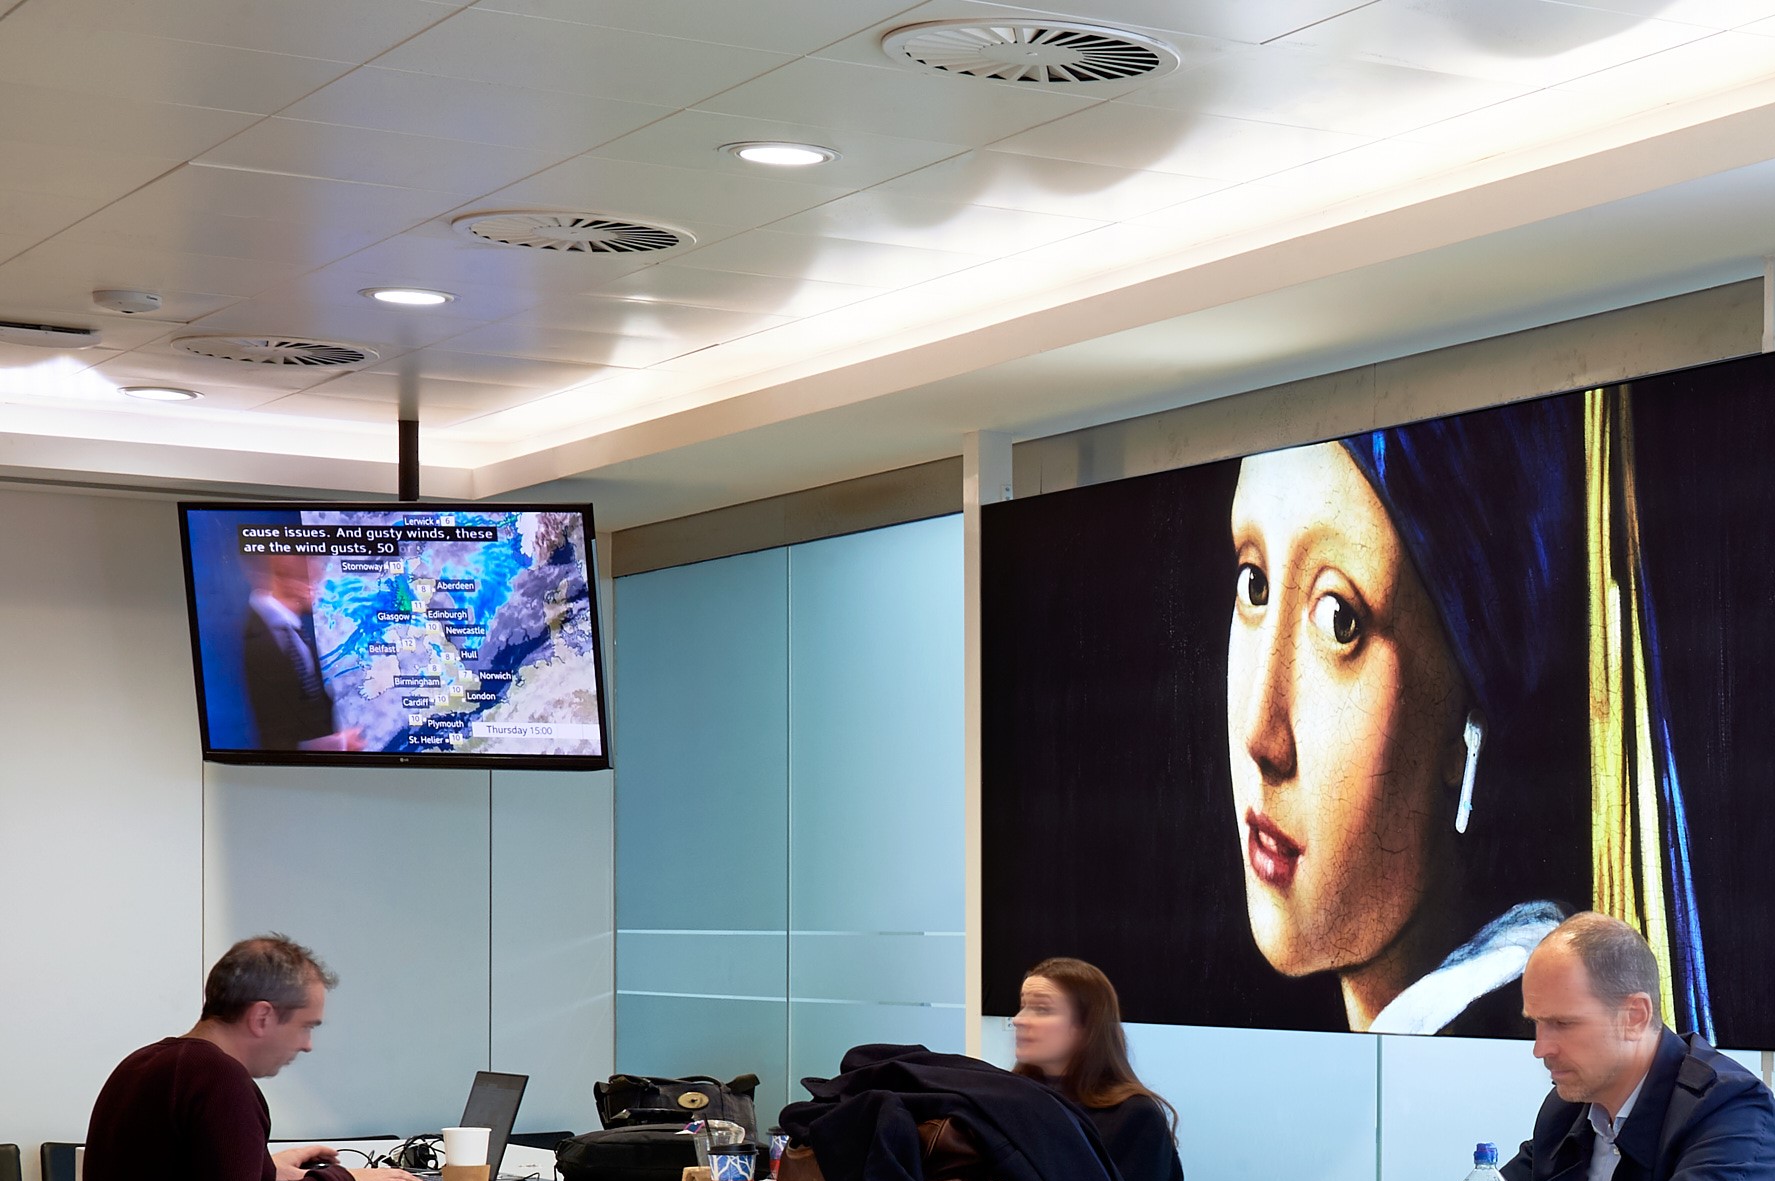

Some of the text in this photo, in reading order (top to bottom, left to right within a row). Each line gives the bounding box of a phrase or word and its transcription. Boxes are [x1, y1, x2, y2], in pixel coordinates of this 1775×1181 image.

[404, 516, 434, 526] Lerwick
[242, 526, 493, 541] cause issues. And gusty winds, these
[243, 543, 265, 553] are
[269, 542, 291, 553] the
[296, 541, 326, 553] wind
[330, 543, 371, 555] gusts,
[341, 561, 383, 572] Stornoway
[392, 562, 401, 570] 10
[436, 580, 475, 591] Aberdeen
[377, 612, 410, 622] Glasgow
[427, 610, 467, 621] Edinburgh
[445, 626, 485, 635] Newcastle
[369, 643, 396, 653] Belfast
[461, 650, 478, 659] Hull
[479, 671, 512, 680] Norwich
[394, 677, 440, 687] Birmingham
[466, 692, 496, 701] London
[403, 698, 429, 706] Cardiff
[427, 719, 464, 729] Plymouth
[486, 725, 553, 737] Thursday 15:00
[408, 735, 443, 744] St. Helier
